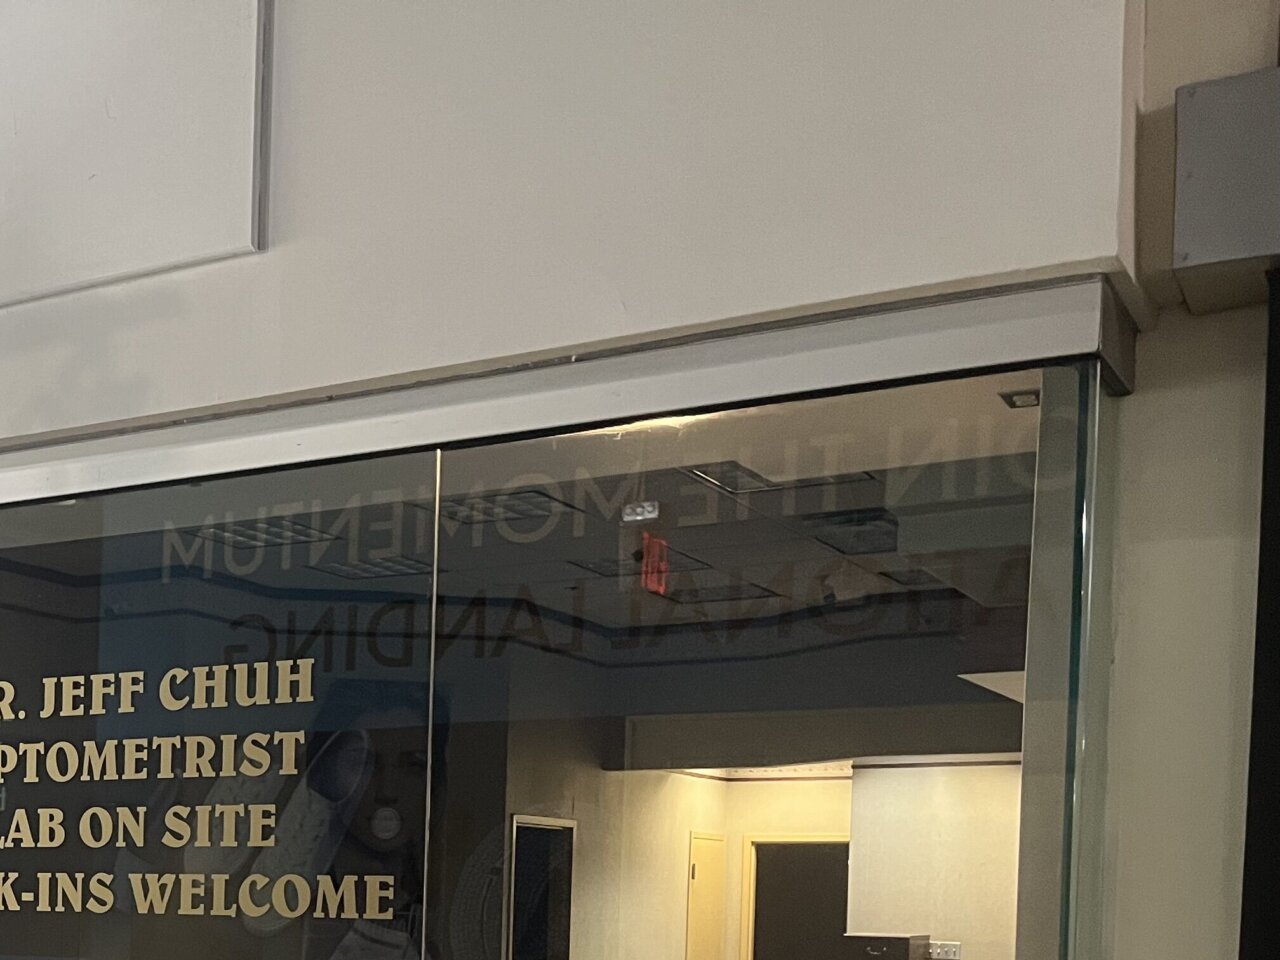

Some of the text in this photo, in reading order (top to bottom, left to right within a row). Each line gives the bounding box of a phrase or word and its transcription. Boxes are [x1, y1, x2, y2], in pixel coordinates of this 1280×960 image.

[40, 670, 144, 719] JEFF
[159, 658, 315, 711] CHUH
[79, 805, 146, 848] ON
[161, 803, 277, 849] SITE
[129, 873, 395, 920] WELCOME
